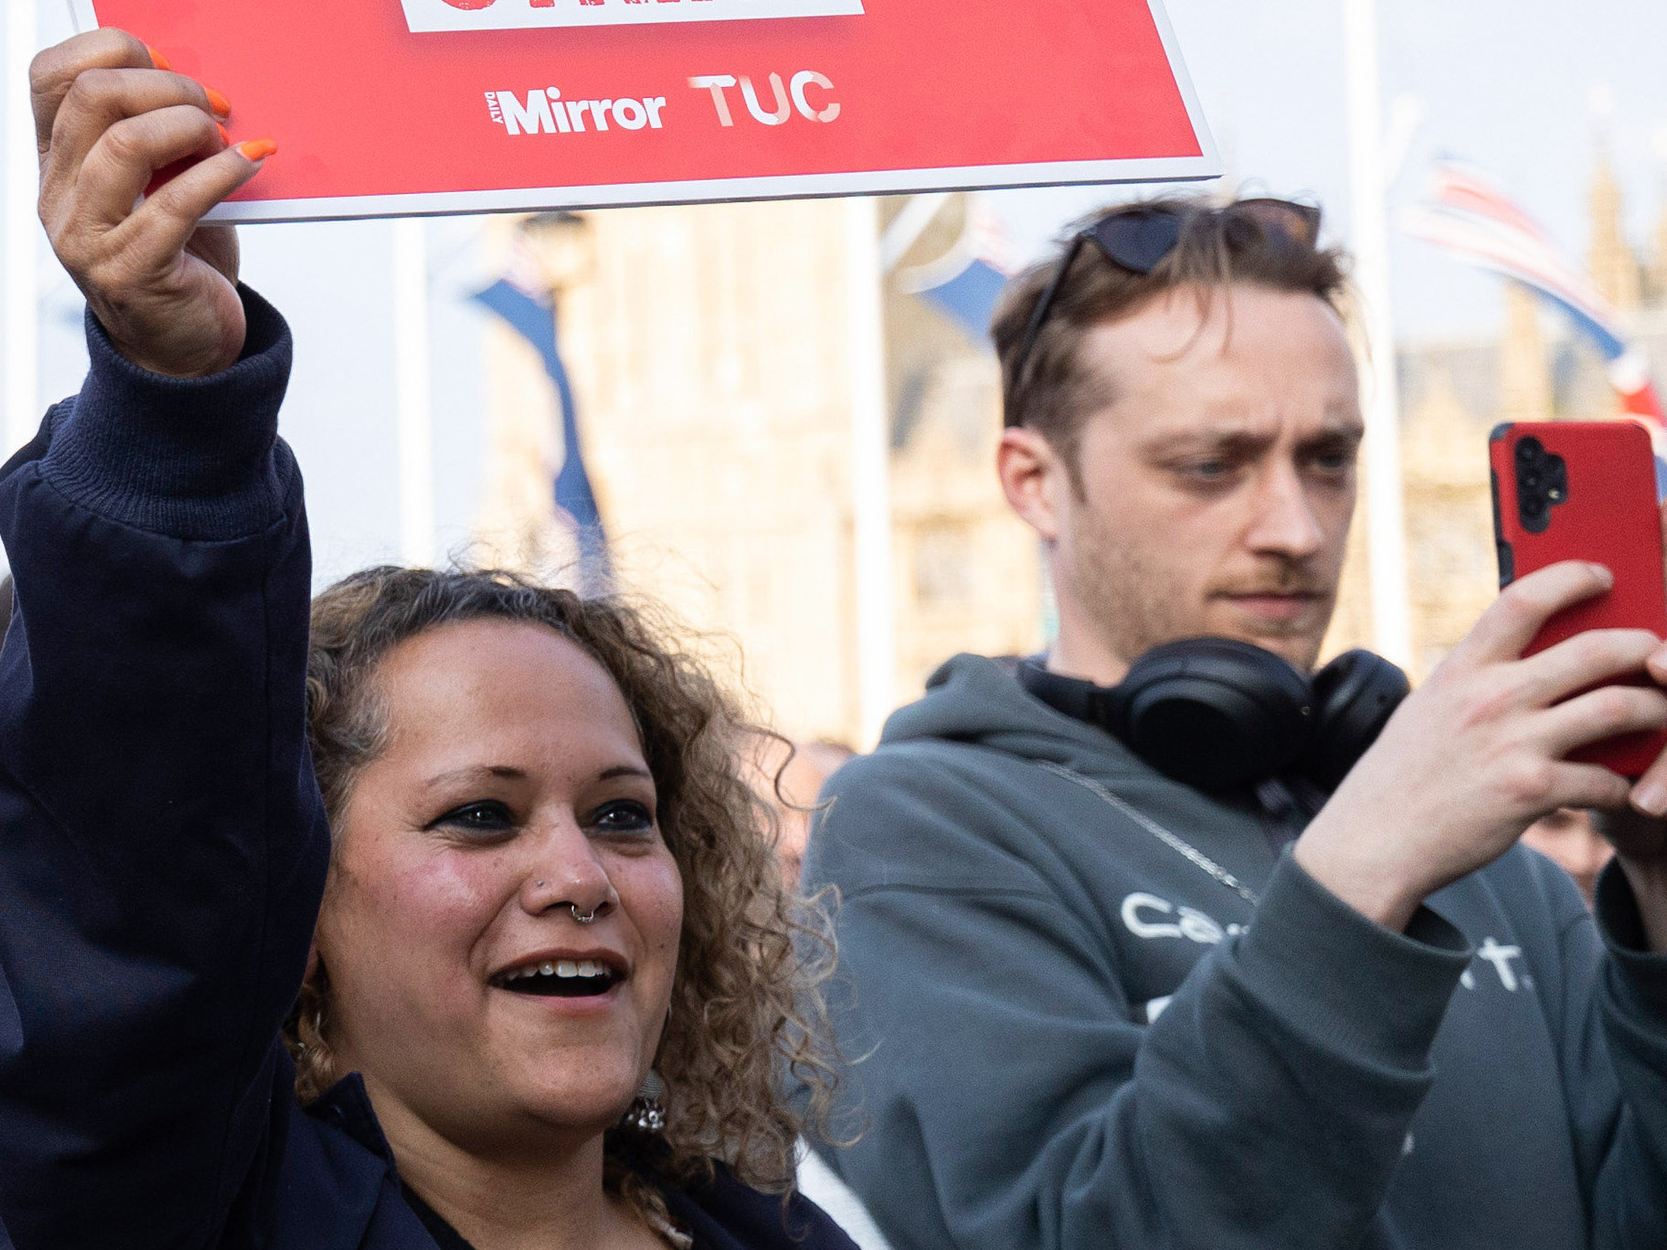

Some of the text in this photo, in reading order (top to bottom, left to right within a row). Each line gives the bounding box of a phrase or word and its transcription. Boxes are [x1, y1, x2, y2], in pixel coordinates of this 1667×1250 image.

[484, 86, 666, 135] DAILY Mirror
[686, 70, 841, 127] TUC
